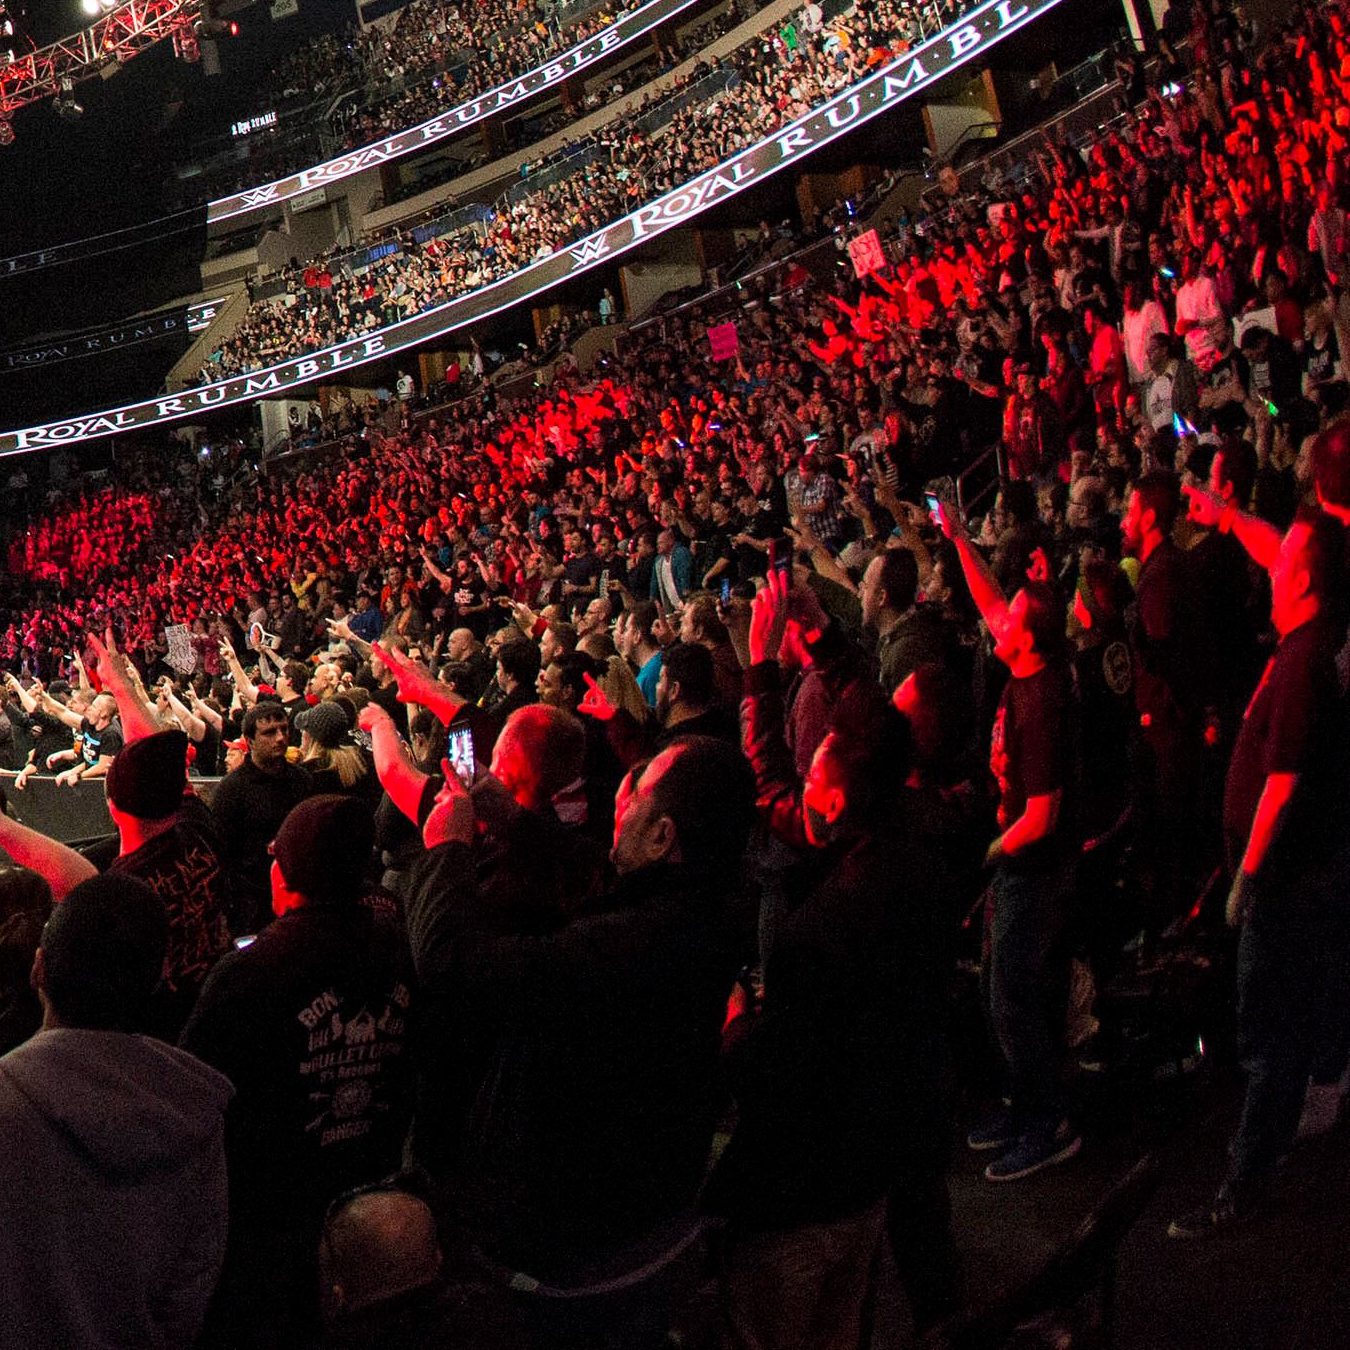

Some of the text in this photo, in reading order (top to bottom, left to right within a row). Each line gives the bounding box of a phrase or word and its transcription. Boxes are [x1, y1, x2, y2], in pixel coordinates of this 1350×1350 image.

[298, 142, 403, 190] ROYAL
[630, 162, 755, 241] ROYAL
[15, 411, 135, 449] ROYAL
